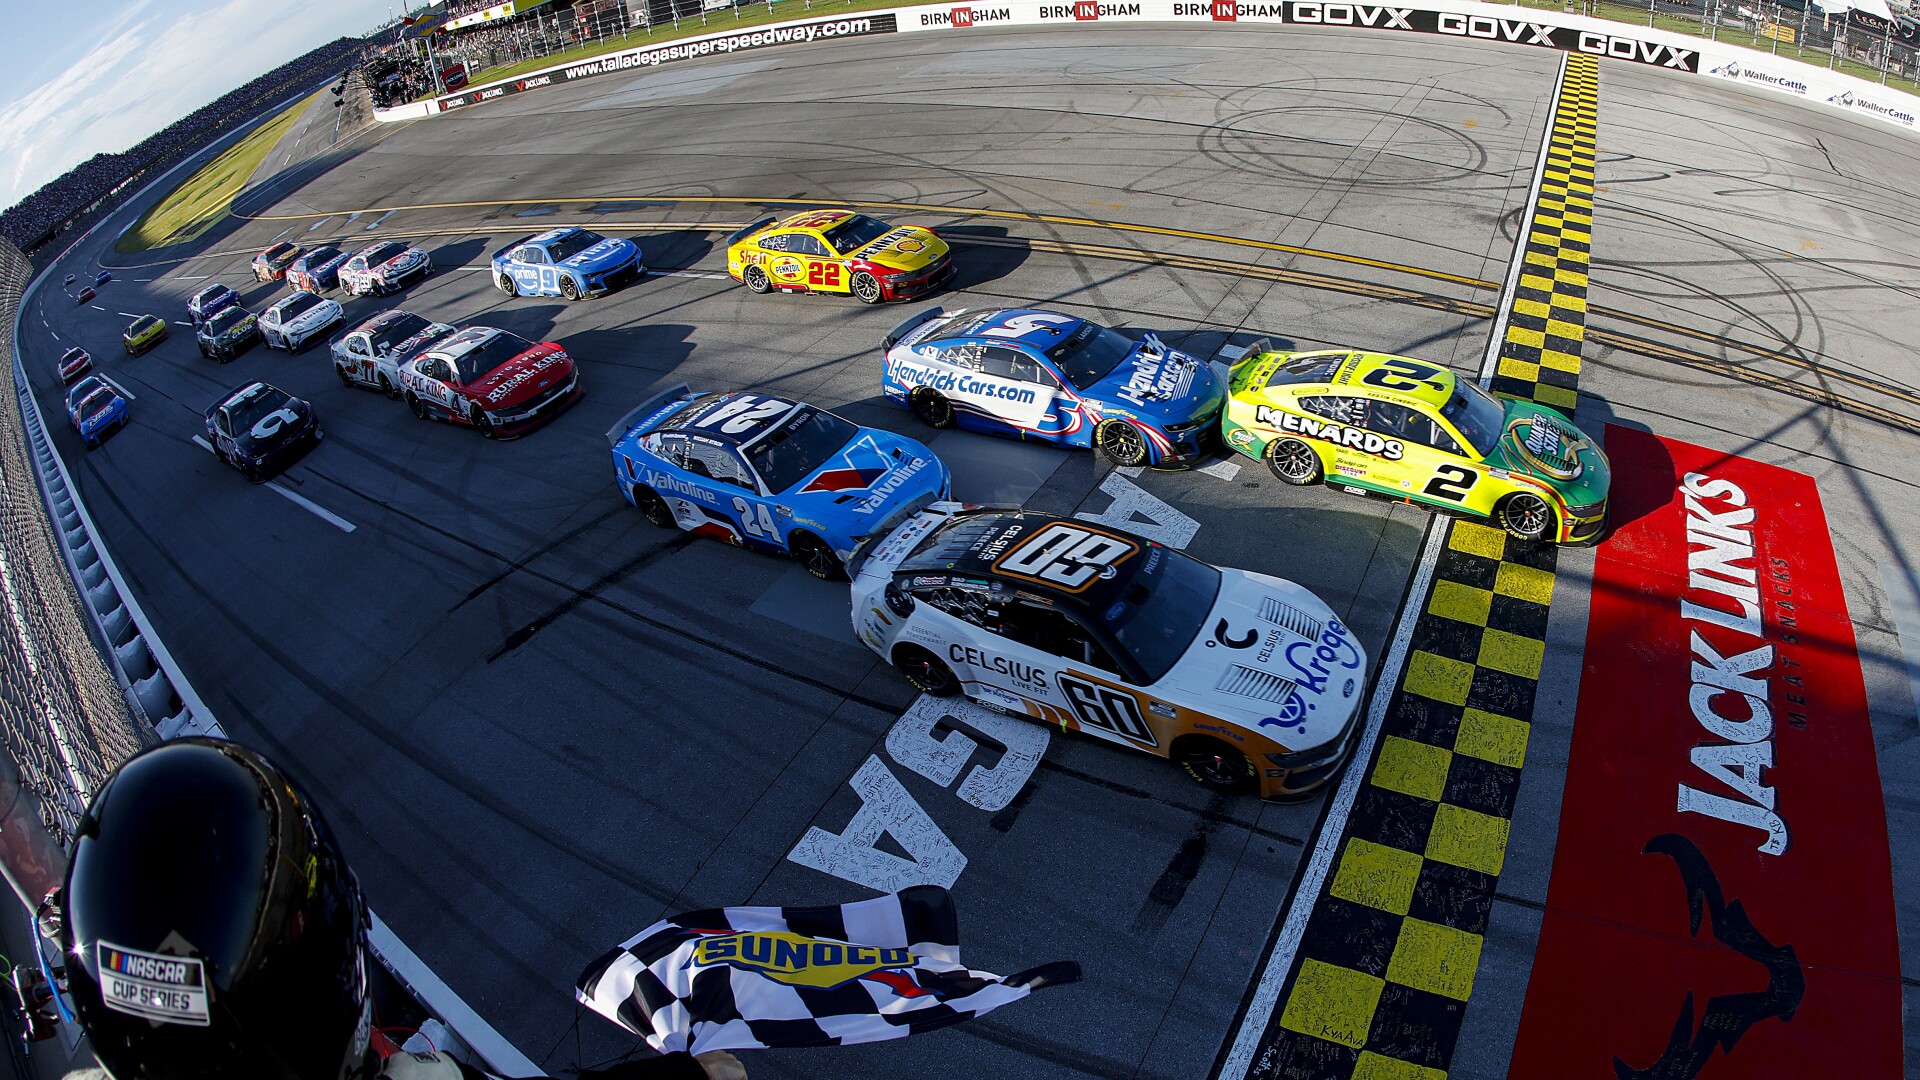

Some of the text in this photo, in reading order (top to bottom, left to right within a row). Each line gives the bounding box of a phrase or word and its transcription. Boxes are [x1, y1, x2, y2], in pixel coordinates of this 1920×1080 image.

[920, 8, 1010, 26] BIRMINGHAM
[1039, 3, 1140, 19] BIRMINGHAM
[1173, 2, 1281, 18] BIRMINGHAM
[1292, 2, 1412, 30] GOVX
[1437, 12, 1556, 47] GOVX
[565, 17, 871, 79] www.talladegasuperspeedway.com
[1579, 31, 1692, 71] GOVX
[740, 250, 767, 265] Shell
[854, 228, 917, 261] PENNZOIL
[514, 267, 538, 281] prime
[775, 263, 801, 275] PENNZOIL
[808, 261, 840, 286] 22
[978, 313, 1074, 338] 5
[361, 360, 376, 382] 77
[486, 350, 568, 403] RURAL KING
[1362, 358, 1441, 392] 2
[425, 378, 448, 401] KING
[1368, 392, 1417, 406] AUSTIN CINDRIC
[788, 412, 811, 432] BYRON
[1036, 394, 1083, 434] 5
[1102, 408, 1138, 420] GOODYEAR
[1255, 404, 1405, 461] MENARDS
[1524, 412, 1549, 455] QUAKER
[1543, 423, 1561, 456] STATE
[1335, 465, 1367, 475] DISCOUNT
[1422, 463, 1479, 503] 2
[646, 469, 716, 504] Valvoline
[1343, 485, 1367, 496] FORD
[731, 496, 784, 544] 24
[1498, 510, 1528, 541] GOODYEAR
[970, 527, 999, 552] PREECE
[999, 525, 1132, 587] 60
[1143, 548, 1162, 576] PREECE
[906, 631, 948, 646] PERFORMANCE
[912, 625, 942, 639] ESSENTIAL
[1257, 629, 1282, 663] CELSIUS
[1771, 556, 1808, 732] MEAT SNACKS
[1677, 470, 1789, 857] JACK LINK'S
[1012, 679, 1048, 696] LIVE FIT
[1057, 673, 1155, 746] 60
[1193, 723, 1246, 743] GOODYEAR
[703, 935, 913, 970] SUNOCO
[125, 953, 187, 984] NASCAR
[113, 979, 191, 1010] CUP SERIES
